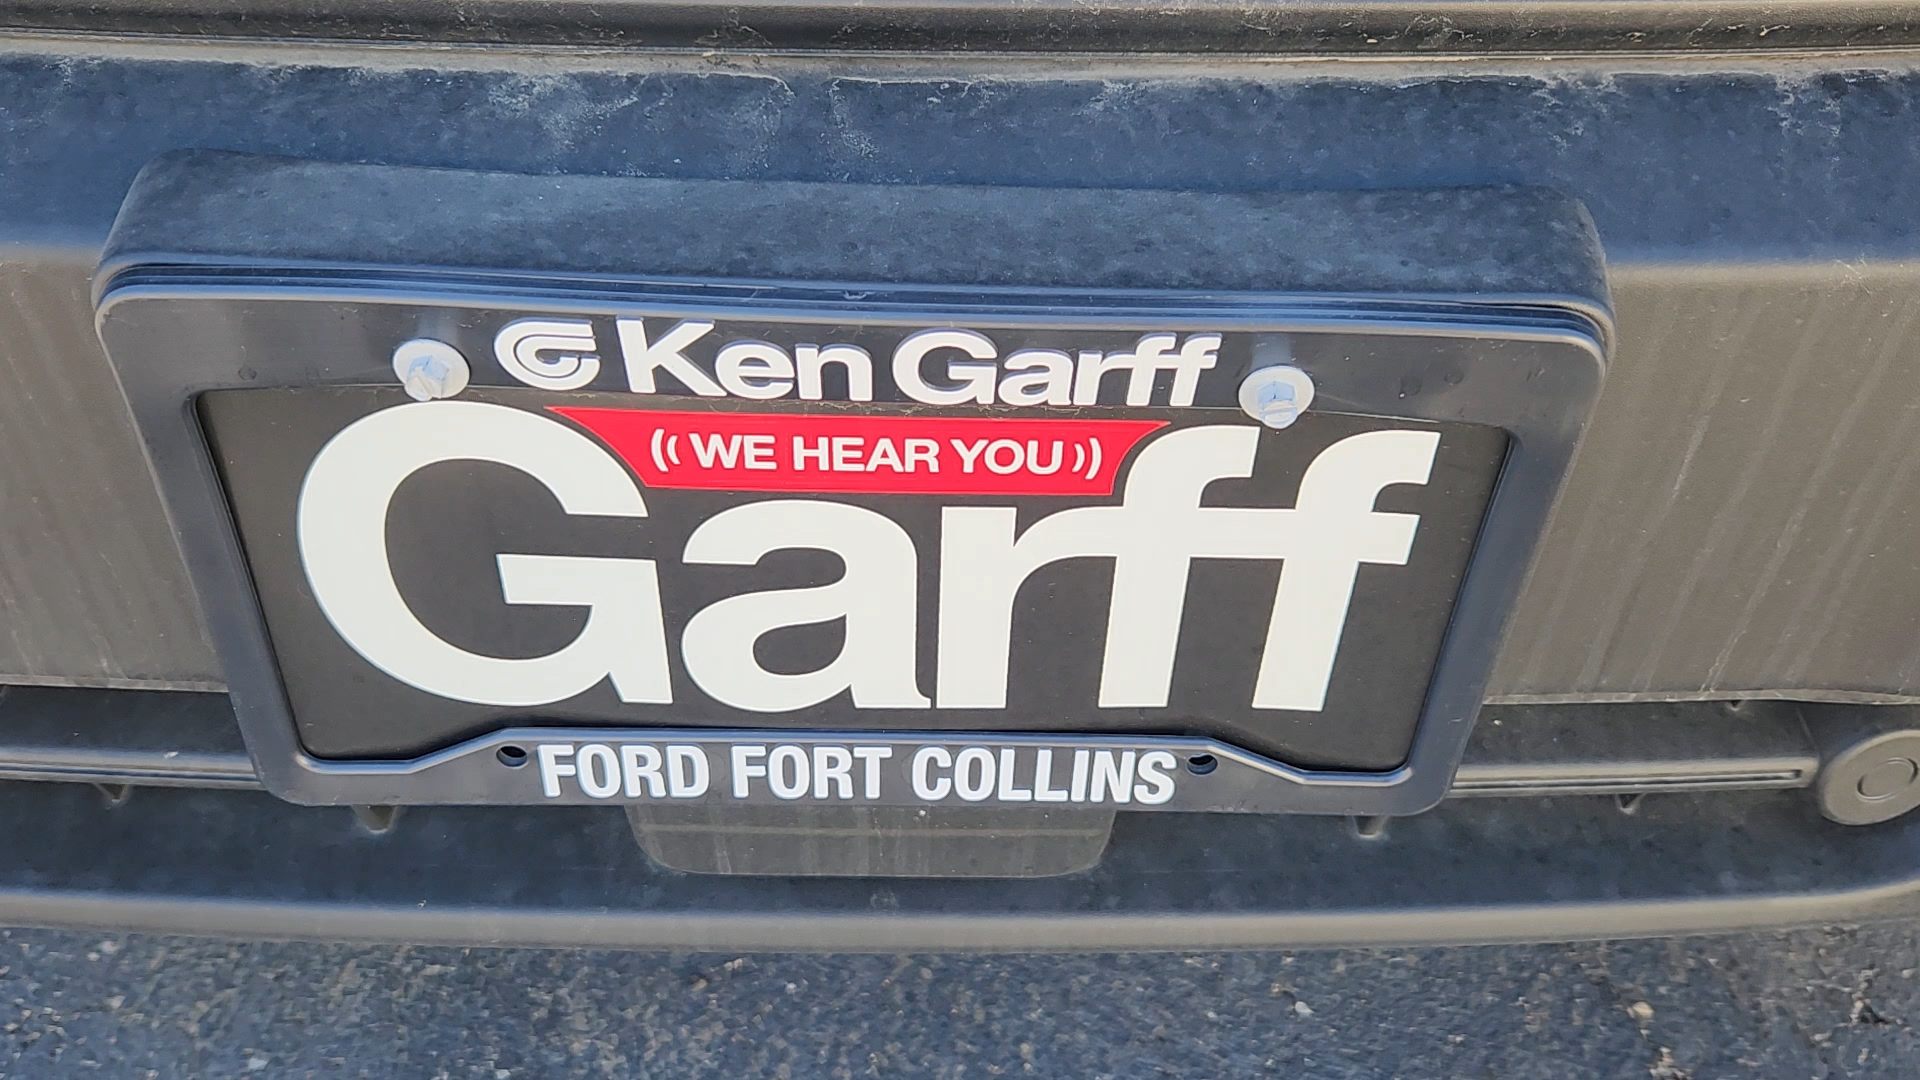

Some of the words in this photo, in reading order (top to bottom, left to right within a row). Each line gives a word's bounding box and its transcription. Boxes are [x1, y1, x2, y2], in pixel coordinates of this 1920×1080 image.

[615, 317, 874, 403] Ken
[892, 329, 1222, 408] Garff
[688, 432, 777, 471] WE
[792, 435, 941, 474] HEAR
[950, 438, 1065, 476] YOU
[297, 400, 1441, 713] Garff
[536, 743, 711, 800] FORD
[730, 744, 894, 802] FORT
[911, 746, 1177, 805] COLLINS
